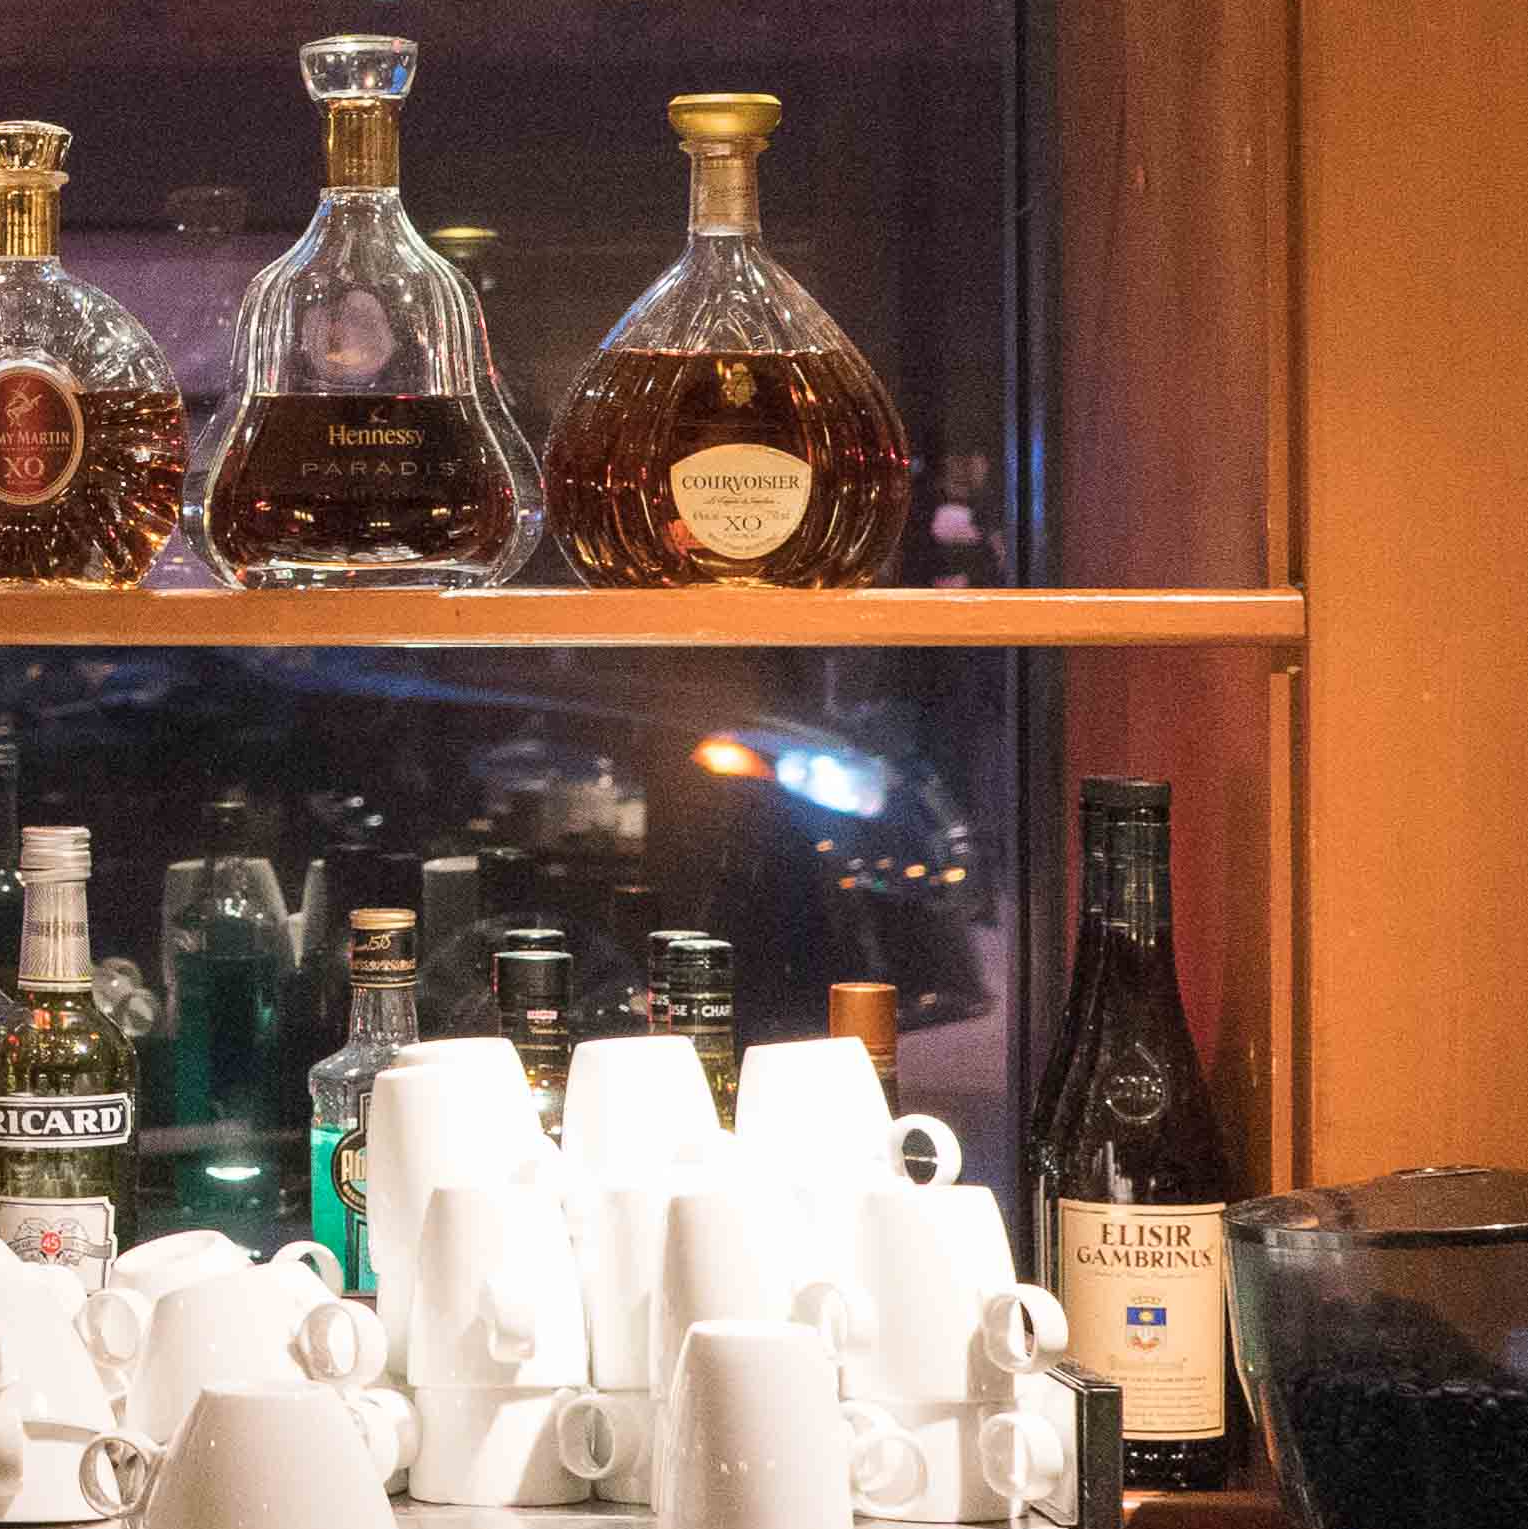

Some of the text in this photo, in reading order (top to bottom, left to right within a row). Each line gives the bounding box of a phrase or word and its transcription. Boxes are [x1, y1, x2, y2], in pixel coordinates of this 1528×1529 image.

[17, 428, 71, 446] MARTIN
[328, 421, 427, 450] Hennessy
[3, 455, 45, 480] XO
[301, 460, 458, 477] PARADIS
[681, 474, 801, 496] COURVOISIER
[722, 515, 764, 532] XO
[1100, 1222, 1192, 1249] ELISIR
[1076, 1245, 1212, 1270] GAMBRINUS
